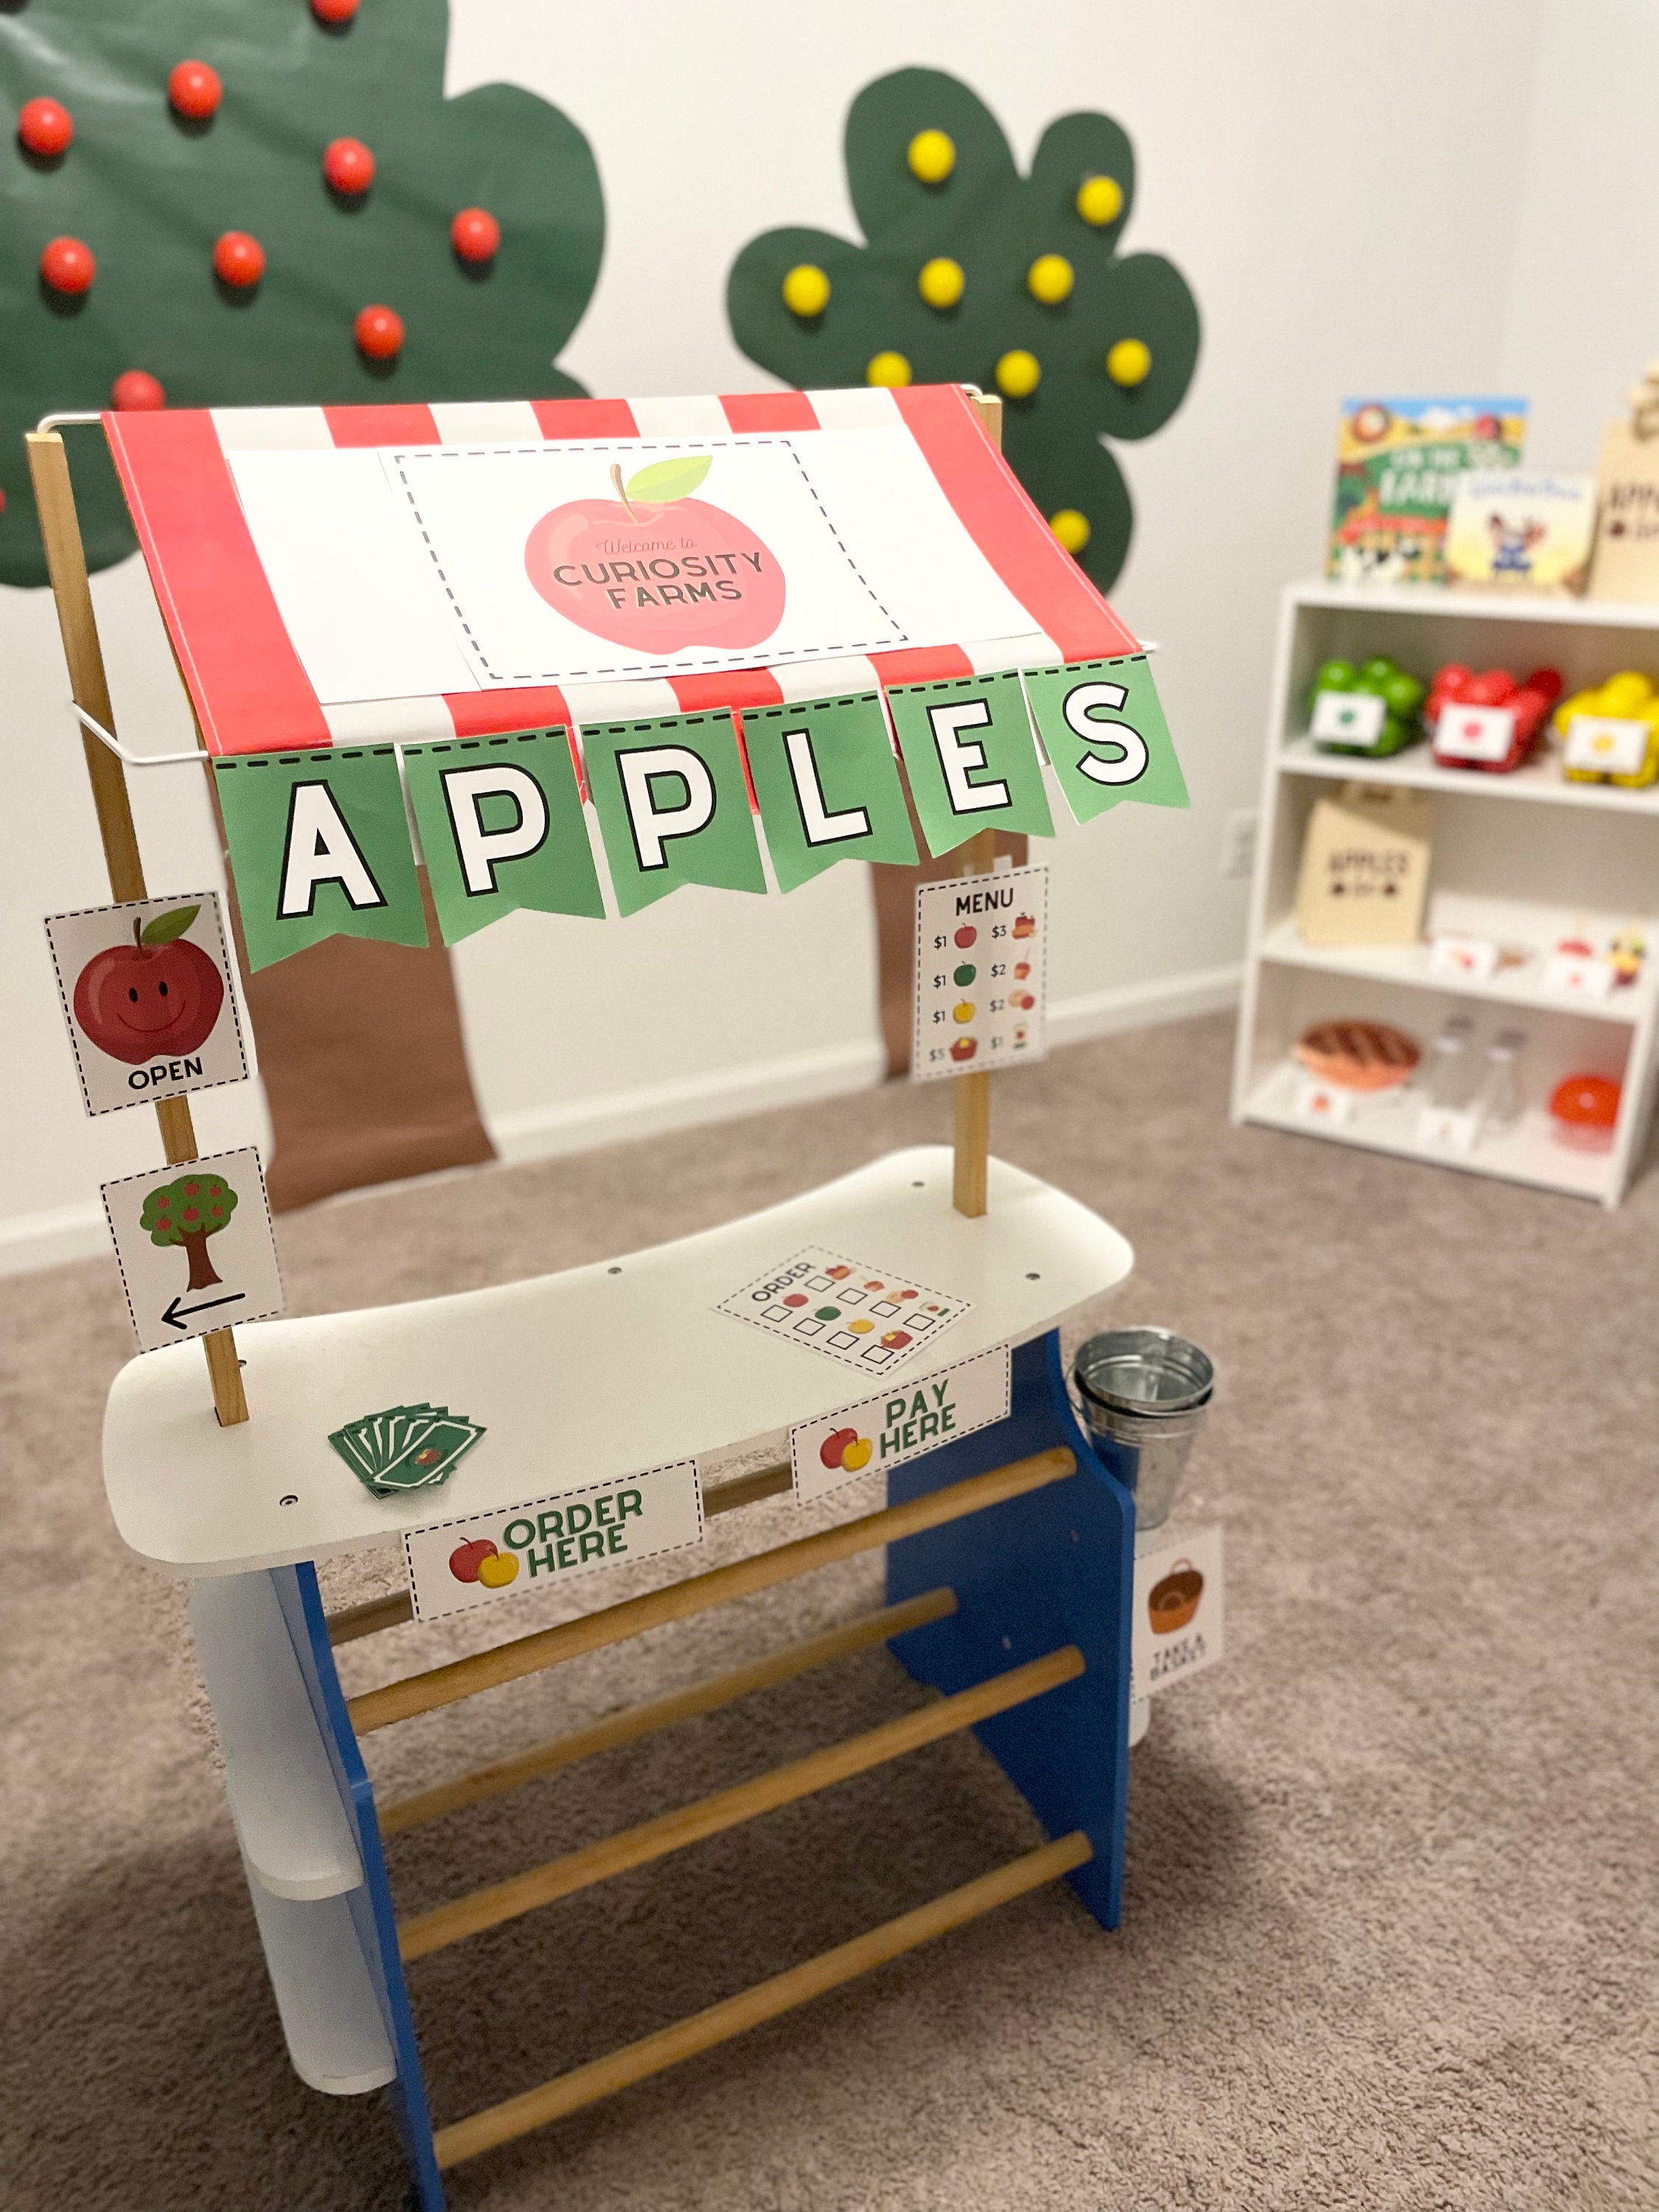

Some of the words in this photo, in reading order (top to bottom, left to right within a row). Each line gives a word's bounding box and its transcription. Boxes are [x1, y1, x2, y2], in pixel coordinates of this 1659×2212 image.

[596, 539, 676, 555] Welcome
[680, 536, 698, 550] to
[553, 552, 763, 587] CURIOSITY
[605, 580, 742, 610] FARMS
[276, 681, 1150, 920] APPLES
[955, 887, 1015, 917] MENU
[933, 935, 947, 950] $1
[991, 925, 1007, 939] $3
[933, 974, 947, 989] $1
[990, 964, 1007, 978] $2
[932, 1010, 946, 1025] $1
[990, 998, 1006, 1013] $2
[128, 1057, 204, 1090] OPEN
[751, 1262, 816, 1302] ORDER
[886, 1379, 949, 1429] PAY
[880, 1402, 956, 1460] HERE
[503, 1488, 644, 1551] ORDER
[526, 1523, 629, 1579] HERE
